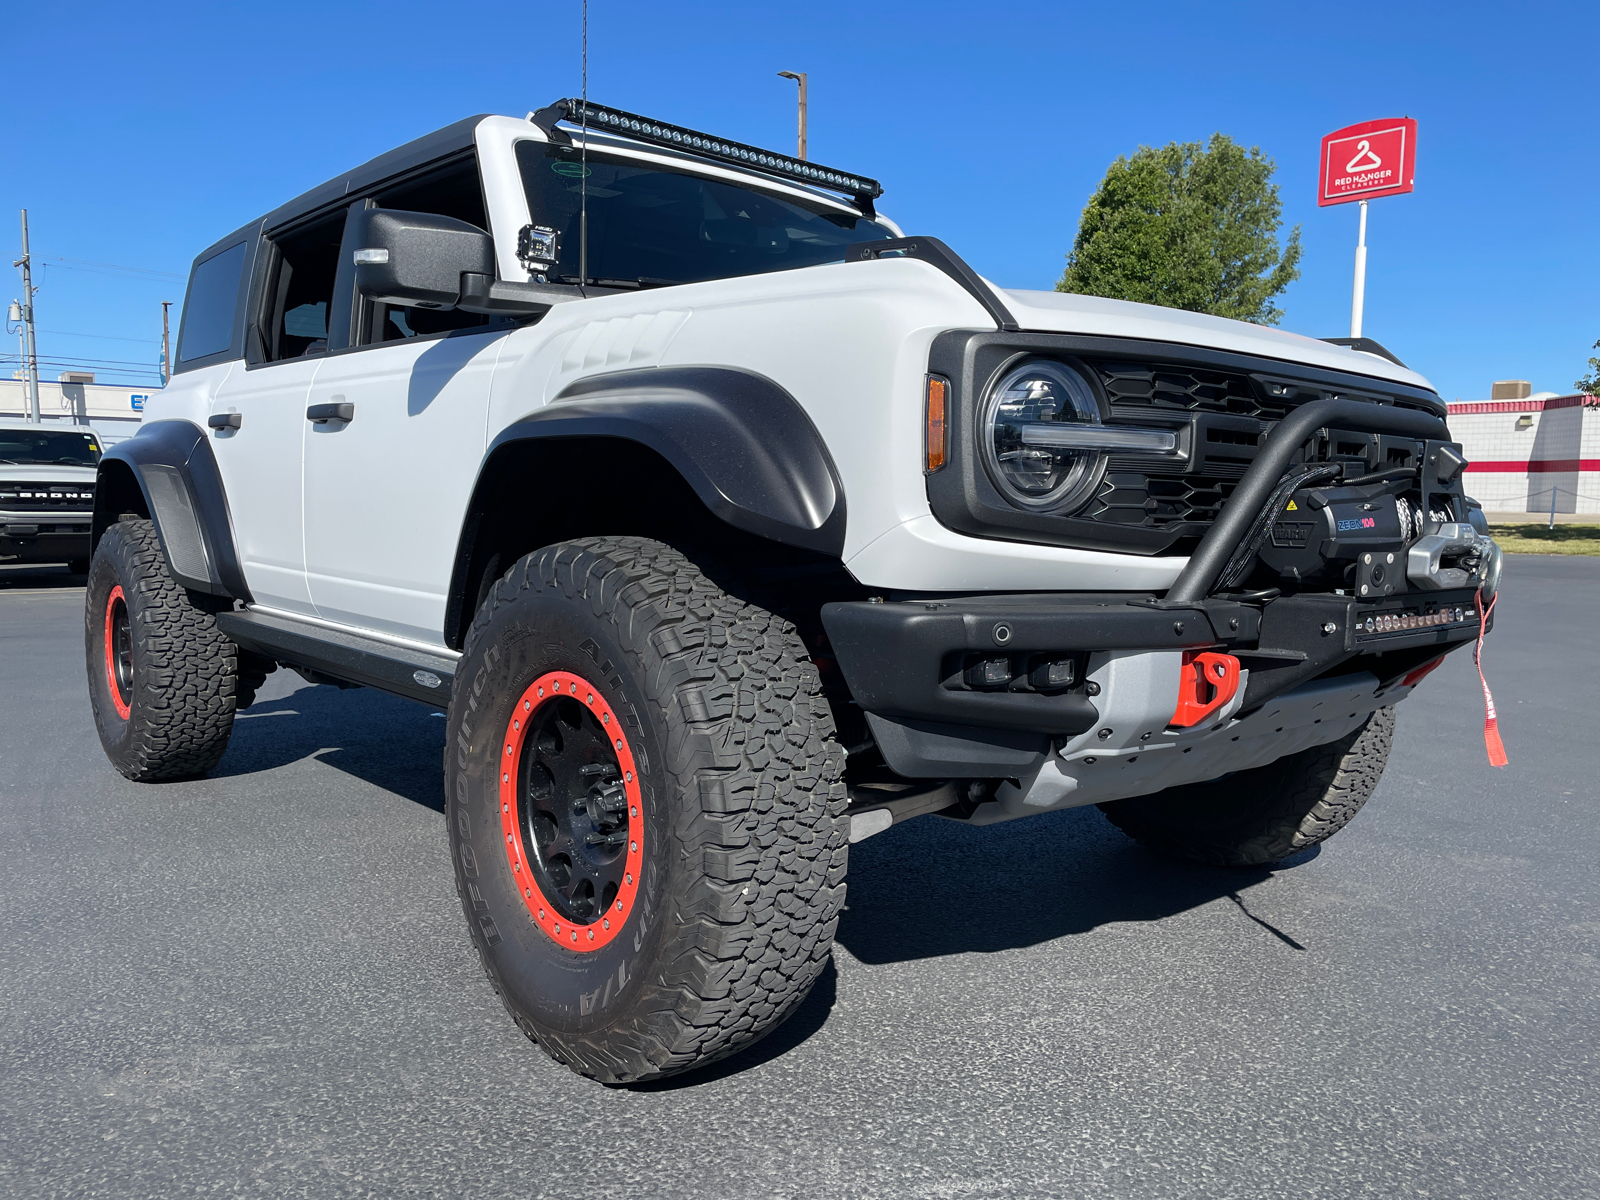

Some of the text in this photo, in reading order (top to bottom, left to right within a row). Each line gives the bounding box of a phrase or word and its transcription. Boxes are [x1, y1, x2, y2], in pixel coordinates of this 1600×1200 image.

[1335, 170, 1392, 186] RED HANGER
[1341, 179, 1384, 190] CLEANERS
[1338, 519, 1364, 531] ZEON
